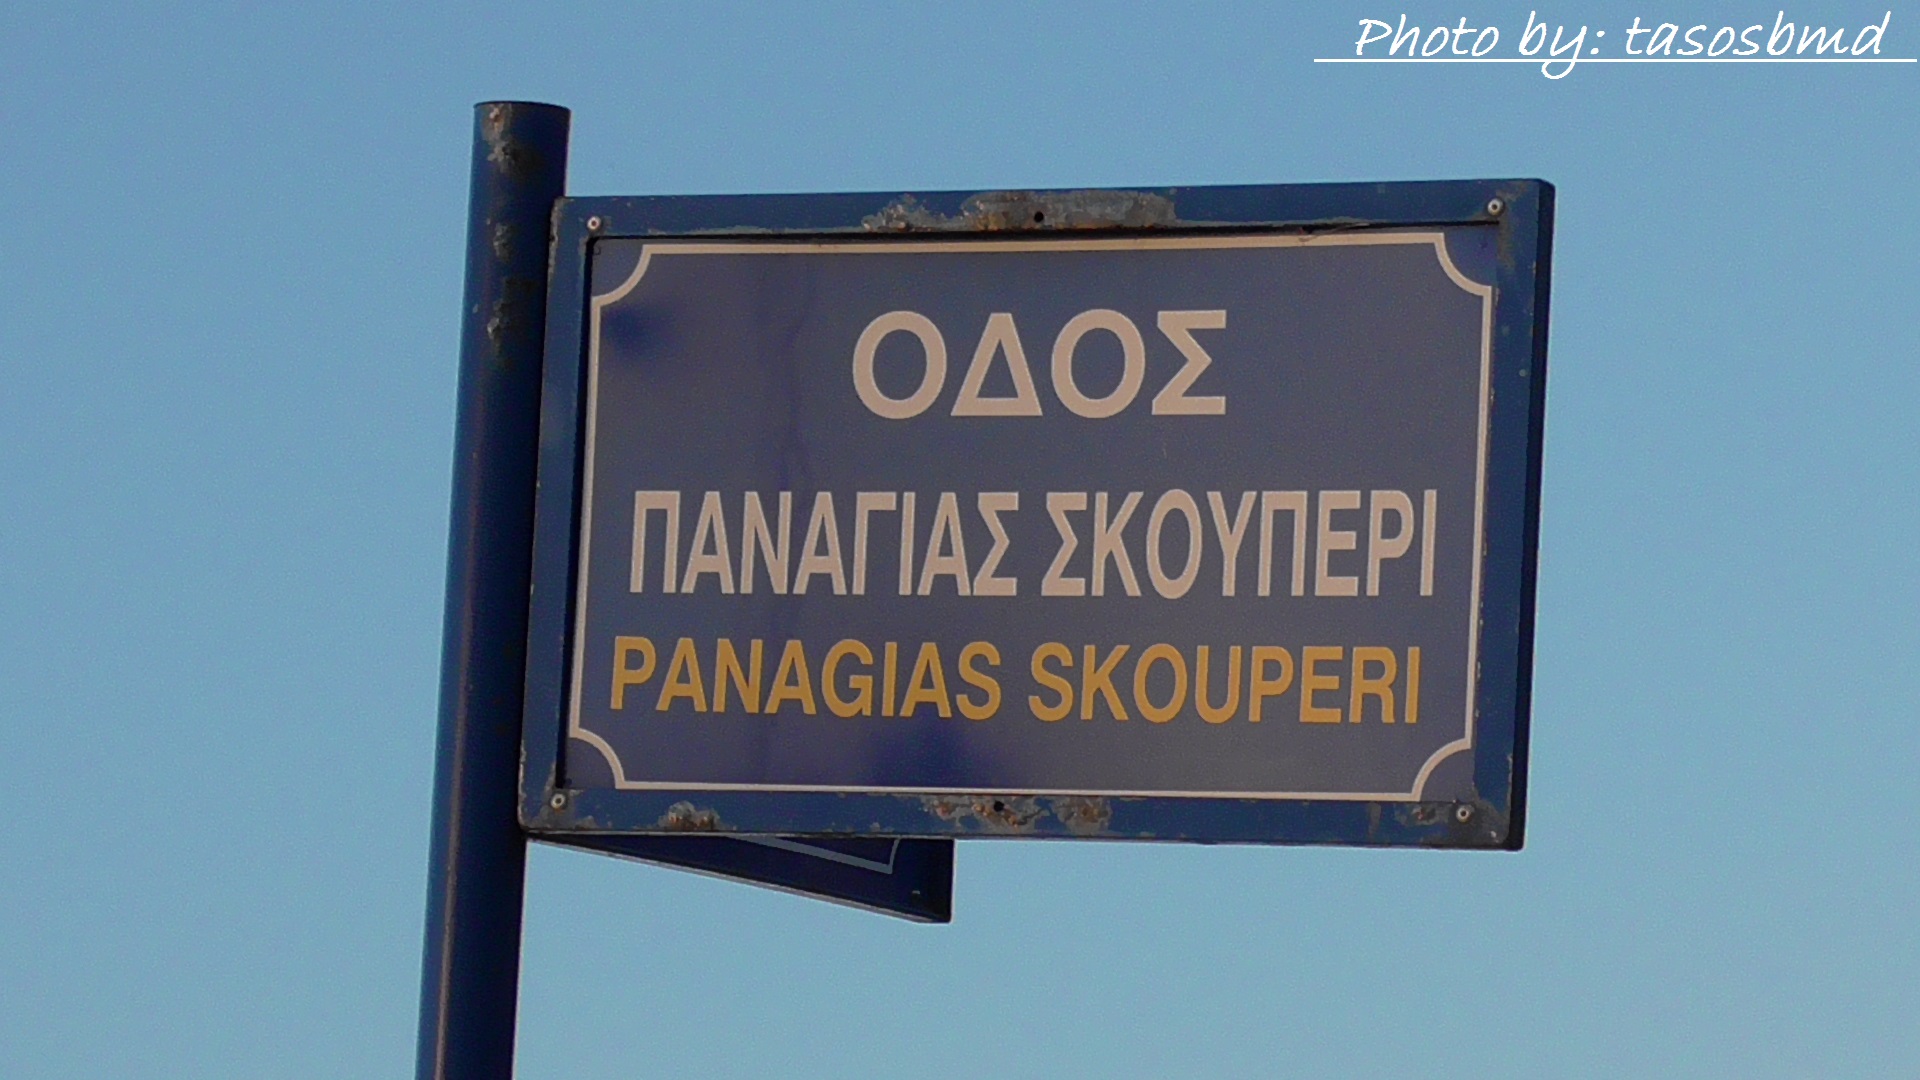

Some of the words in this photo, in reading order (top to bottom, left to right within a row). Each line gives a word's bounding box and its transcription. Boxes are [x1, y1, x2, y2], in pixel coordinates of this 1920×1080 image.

[852, 308, 1227, 419] ΟΔΟΣ
[629, 490, 1019, 596] ΠΑΝΑΓΙΑΣ
[1040, 488, 1438, 600] ΣΚΟΥΠΕΡΙ
[610, 635, 1003, 721] PANAGIAS
[1028, 641, 1422, 726] SKOUPERI
